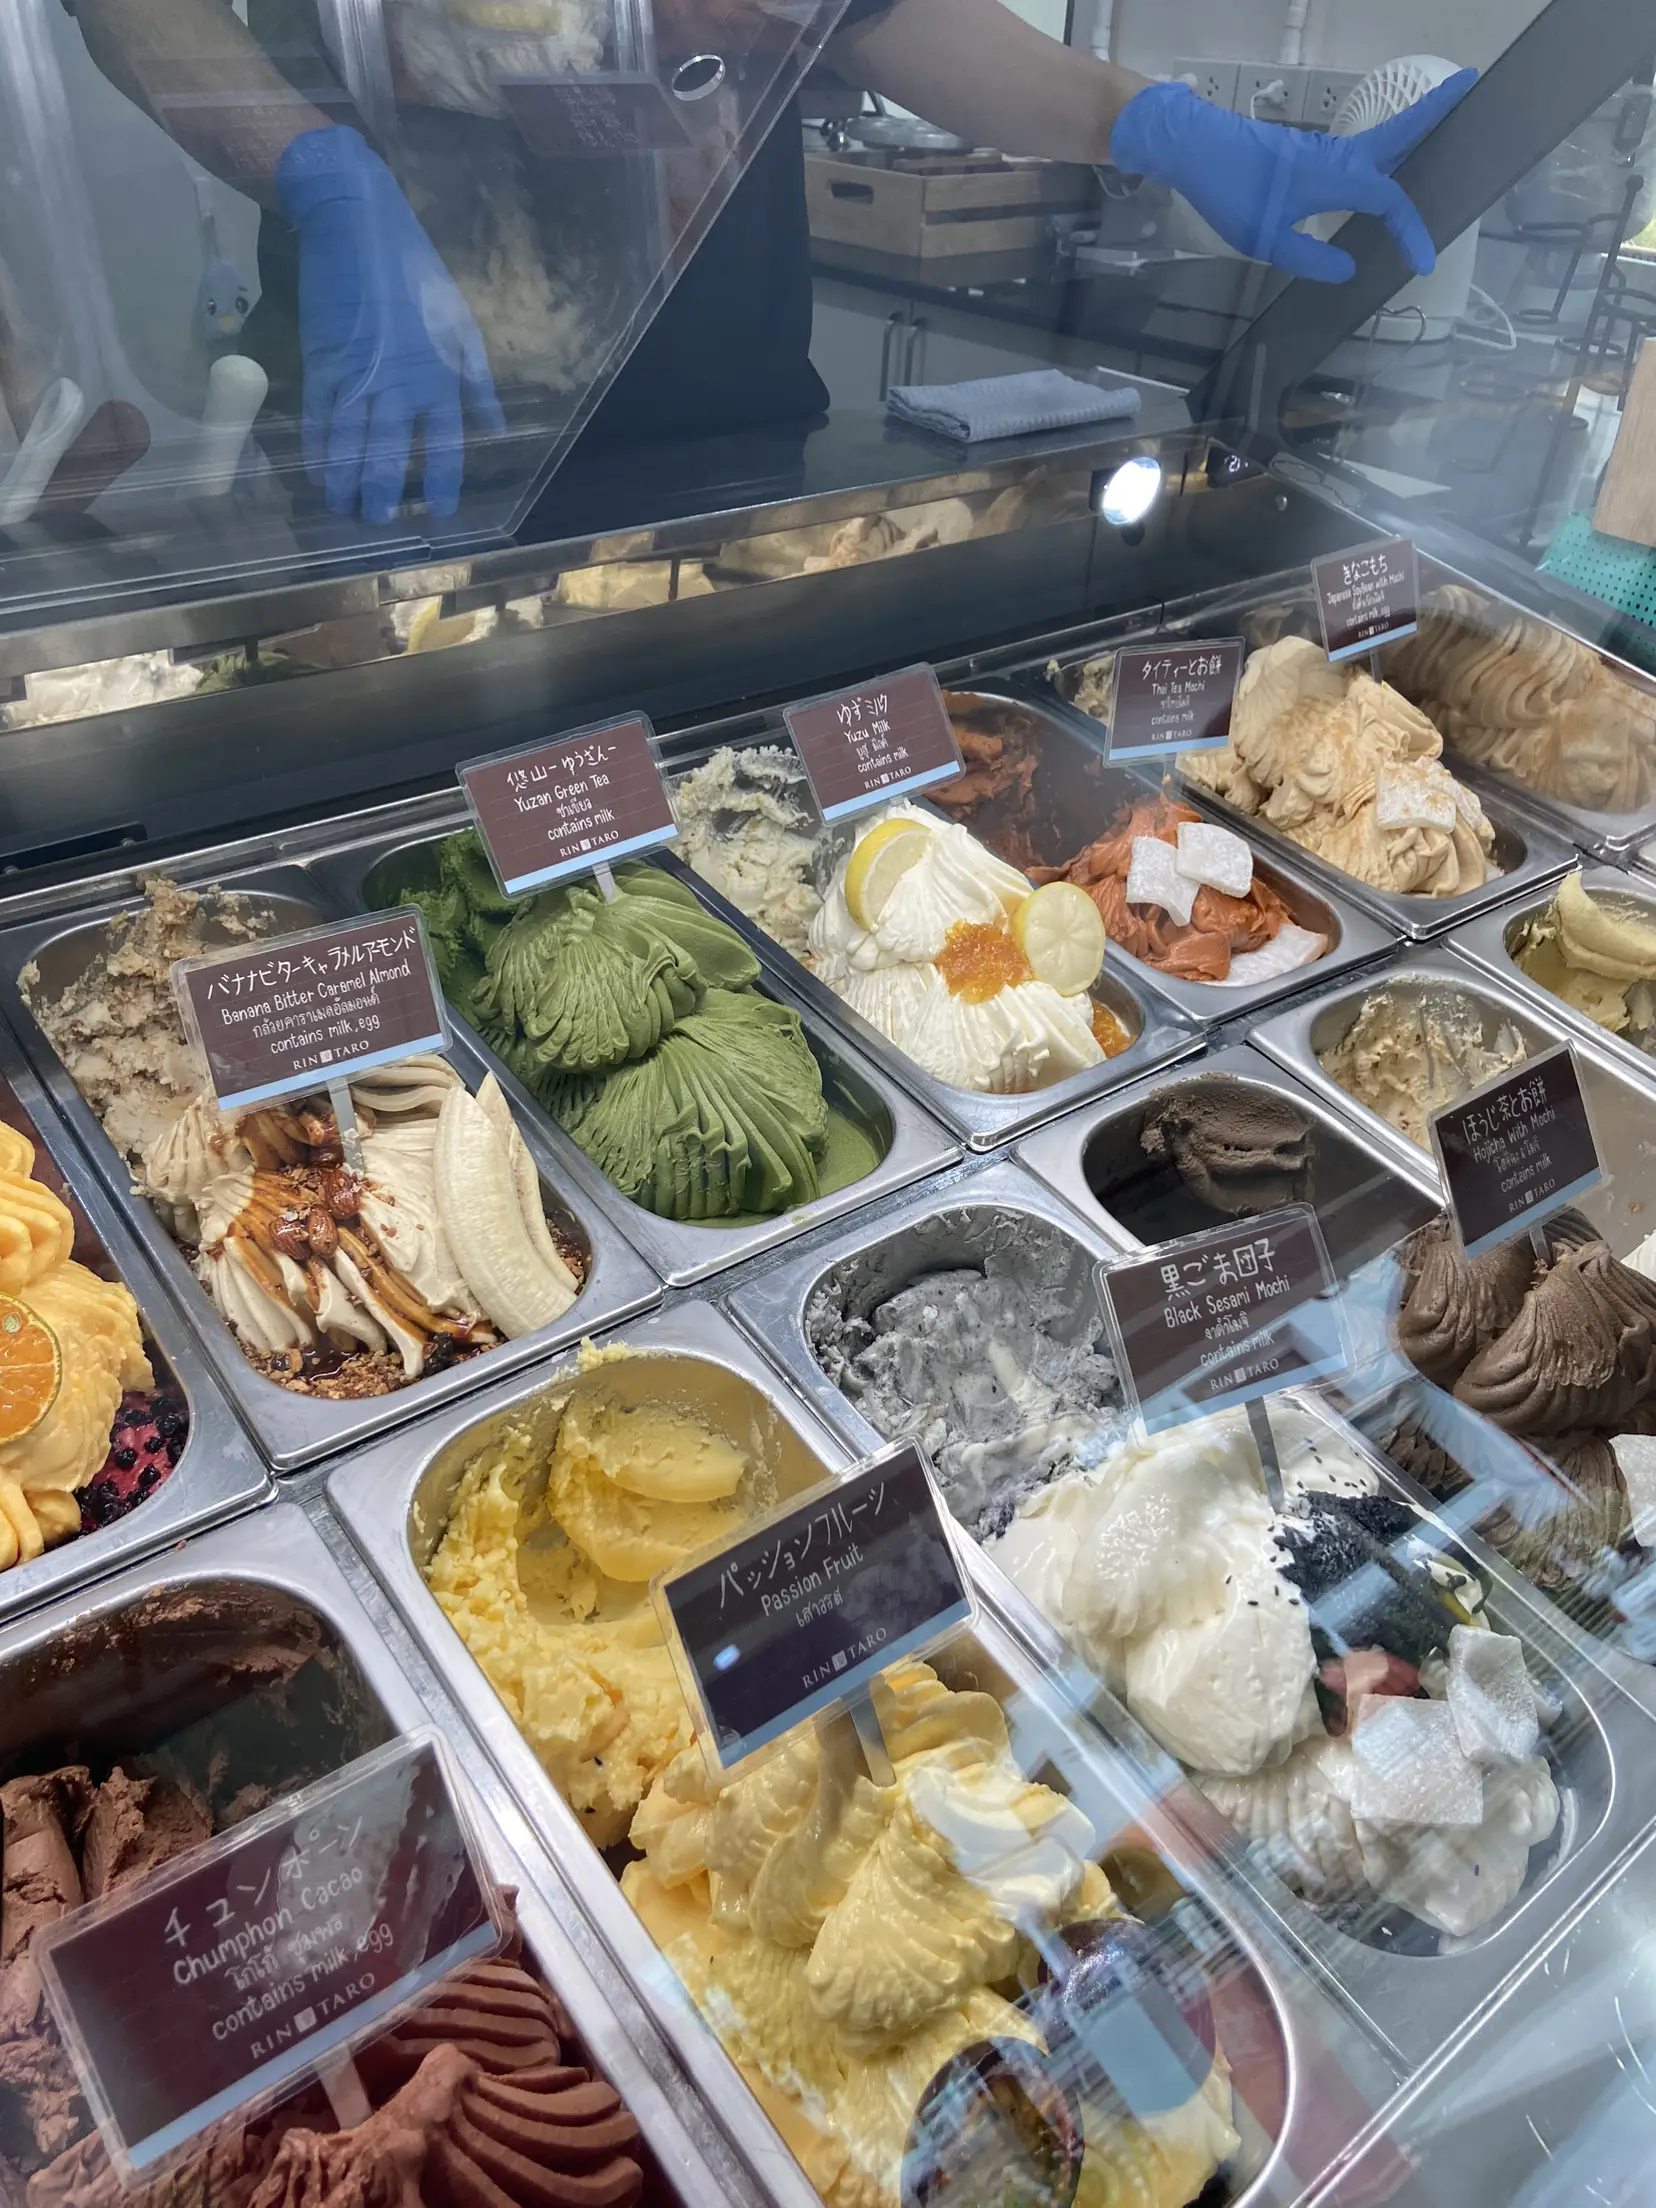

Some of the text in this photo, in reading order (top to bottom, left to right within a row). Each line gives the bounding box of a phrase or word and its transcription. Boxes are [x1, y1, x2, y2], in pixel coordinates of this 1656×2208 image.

[1343, 553, 1388, 585] きなこもち
[1346, 611, 1368, 627] contains
[1142, 654, 1222, 680] タイティーとお餅
[1152, 680, 1205, 695] Thai Tea Mochi
[844, 719, 891, 744] Yuzu Milk
[1151, 710, 1195, 725] contains milk
[857, 746, 908, 773] contains milk
[864, 766, 912, 790] RIN TARO
[514, 772, 610, 812] Yuzan Green Tea
[548, 808, 616, 840] contains milk
[560, 830, 620, 858] RIN TARO
[221, 958, 412, 1026] Banana Bitter Caramel Almond
[270, 1026, 324, 1054] contains
[293, 1040, 370, 1070] RIN TARO
[1462, 1076, 1548, 1144] ほうじ茶とお餅
[1474, 1136, 1506, 1164] Hojicha
[1530, 1105, 1556, 1130] Mochi
[1501, 1155, 1553, 1193] contains milk
[1509, 1178, 1556, 1212] RIN TARO
[1160, 1238, 1276, 1302] 黒ごま団子
[1164, 1275, 1290, 1328] Black Sesami Mochi
[1200, 1329, 1276, 1367] contains milk
[1210, 1358, 1278, 1391] RIN TARO
[720, 1482, 884, 1608] パッションフルーツ
[760, 1544, 864, 1616] Passion Fruit
[796, 1586, 844, 1628] เสาวรส
[802, 1627, 887, 1688] RIN TARO
[174, 1866, 363, 1986] Chumphon Cacao
[212, 1977, 306, 2042] contains
[250, 1971, 376, 2060] RIN TARO
